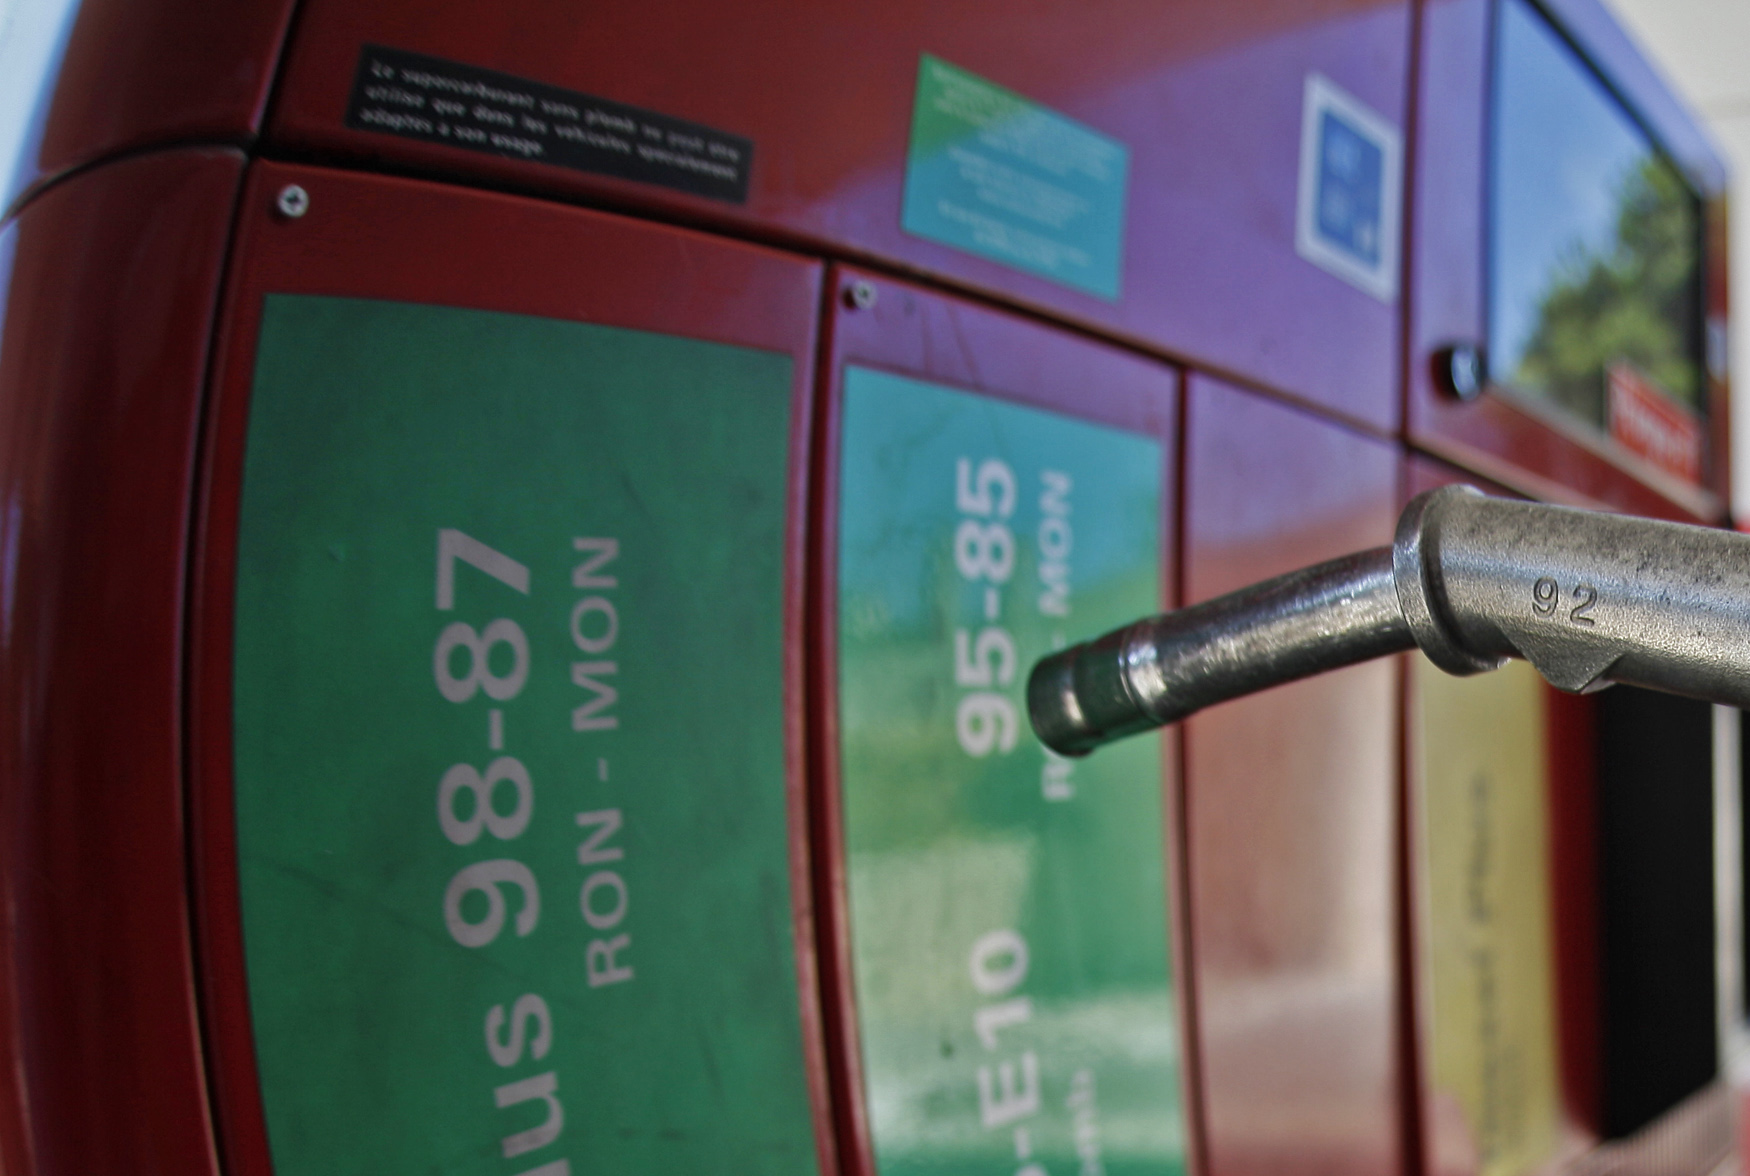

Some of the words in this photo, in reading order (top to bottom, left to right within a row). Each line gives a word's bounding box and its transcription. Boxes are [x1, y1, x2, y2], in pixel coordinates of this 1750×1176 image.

[954, 456, 1020, 758] 95-85
[1036, 468, 1074, 617] MON
[1532, 576, 1598, 627] 92
[570, 537, 620, 731] MON
[433, 527, 541, 948] 98-87
[599, 758, 609, 782] -
[574, 808, 635, 989] RON
